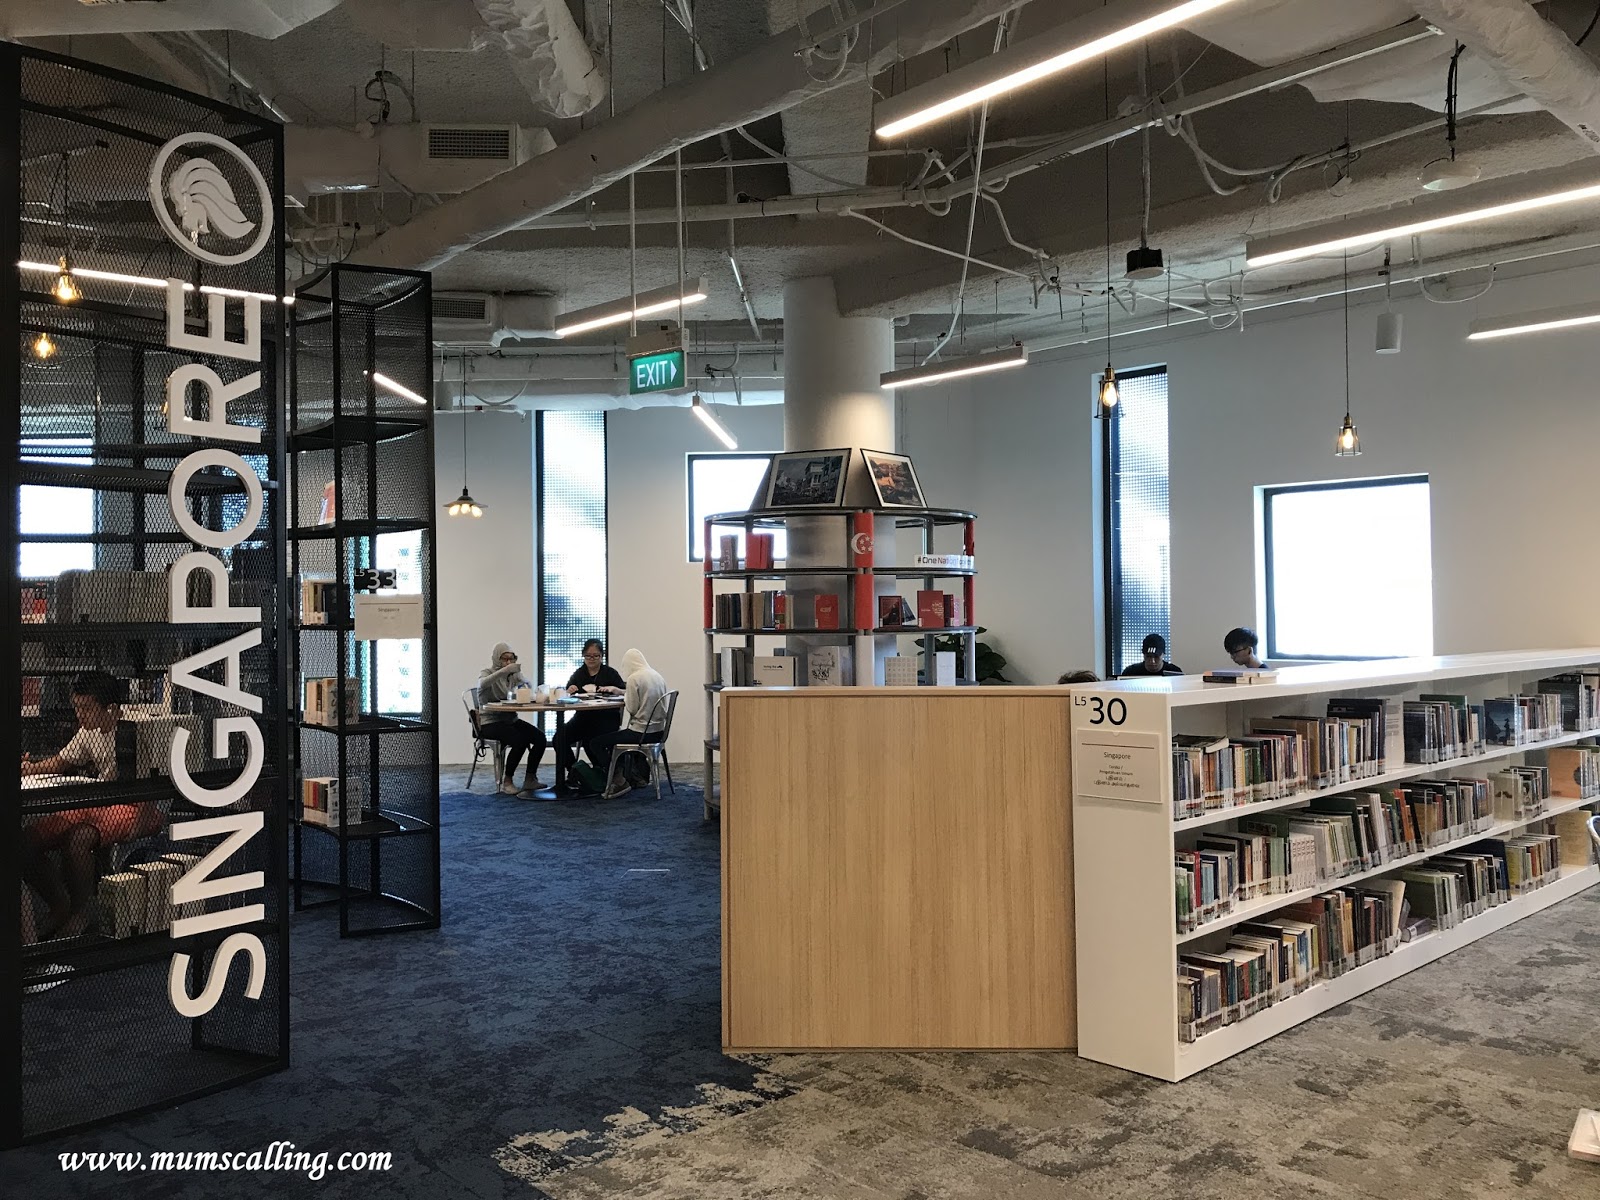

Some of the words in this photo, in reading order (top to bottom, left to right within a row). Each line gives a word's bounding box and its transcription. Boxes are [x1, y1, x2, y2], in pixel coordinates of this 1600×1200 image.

[636, 360, 668, 389] EXIT
[367, 569, 396, 590] 33
[167, 277, 267, 1018] SINGAPORE
[1074, 695, 1087, 706] L5
[1089, 696, 1127, 726] 30
[1103, 751, 1131, 760] Singapore
